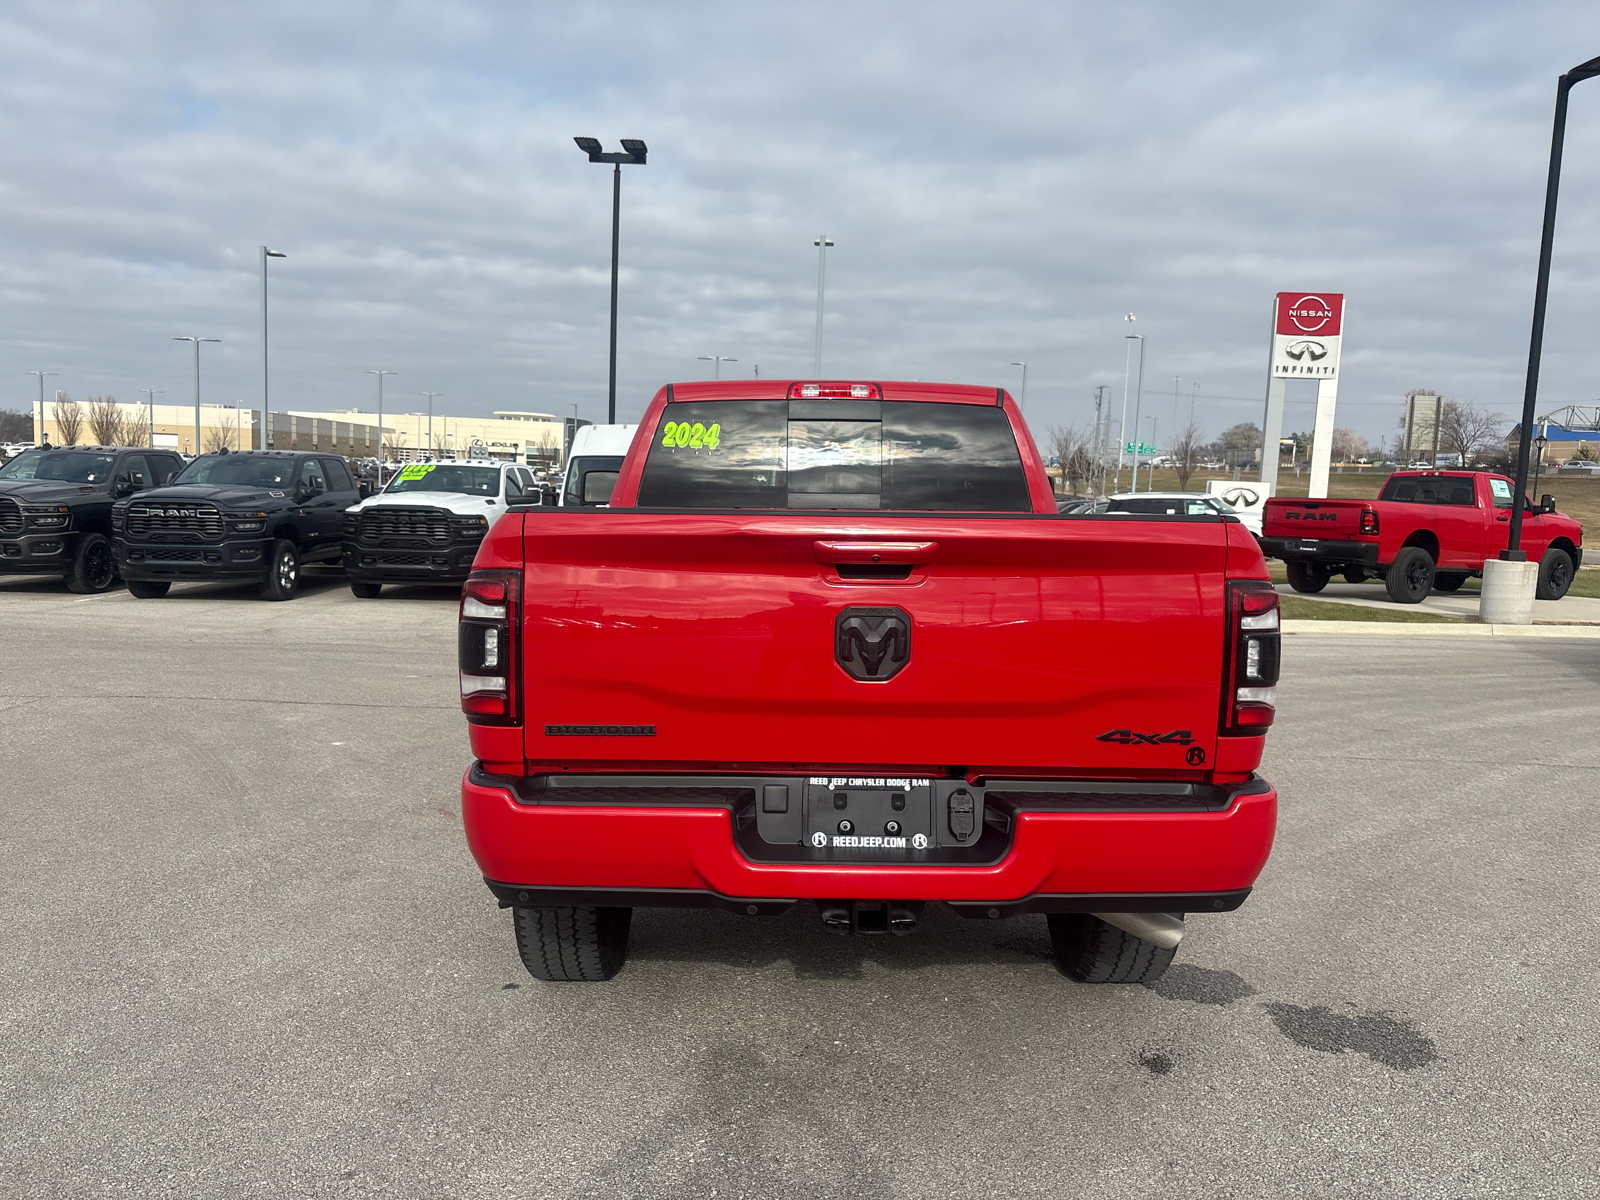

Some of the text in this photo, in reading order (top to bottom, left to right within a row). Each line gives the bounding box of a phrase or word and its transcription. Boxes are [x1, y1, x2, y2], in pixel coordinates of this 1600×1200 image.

[1289, 309, 1332, 317] NISSAN
[1275, 365, 1335, 375] INFINITI
[662, 421, 721, 450] 2024
[149, 509, 196, 517] RAM
[1285, 512, 1337, 521] RAM
[1095, 728, 1197, 746] 4x4
[809, 777, 930, 787] REED JEEP CHRYSLER DODGE RAM
[832, 836, 906, 848] REEDJEEP.COM
